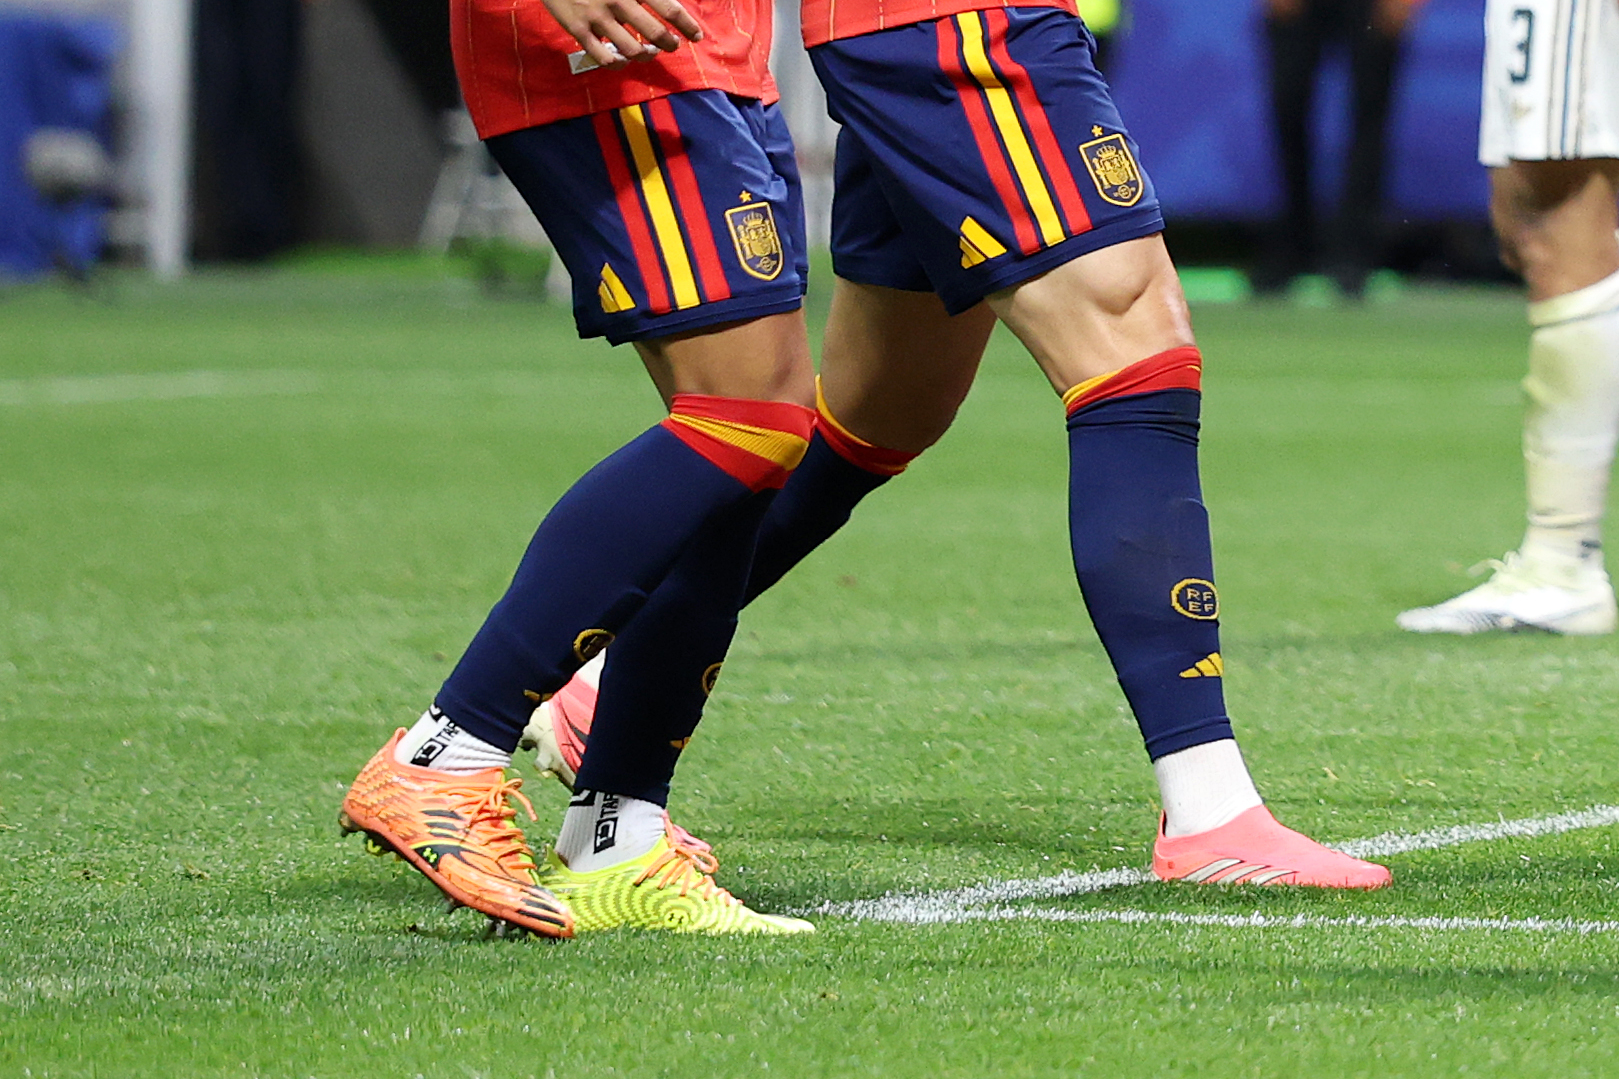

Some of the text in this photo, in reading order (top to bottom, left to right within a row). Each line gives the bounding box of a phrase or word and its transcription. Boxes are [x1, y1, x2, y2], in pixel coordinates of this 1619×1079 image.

[1508, 7, 1534, 85] 3
[1186, 587, 1213, 602] RF
[1188, 601, 1214, 613] EF
